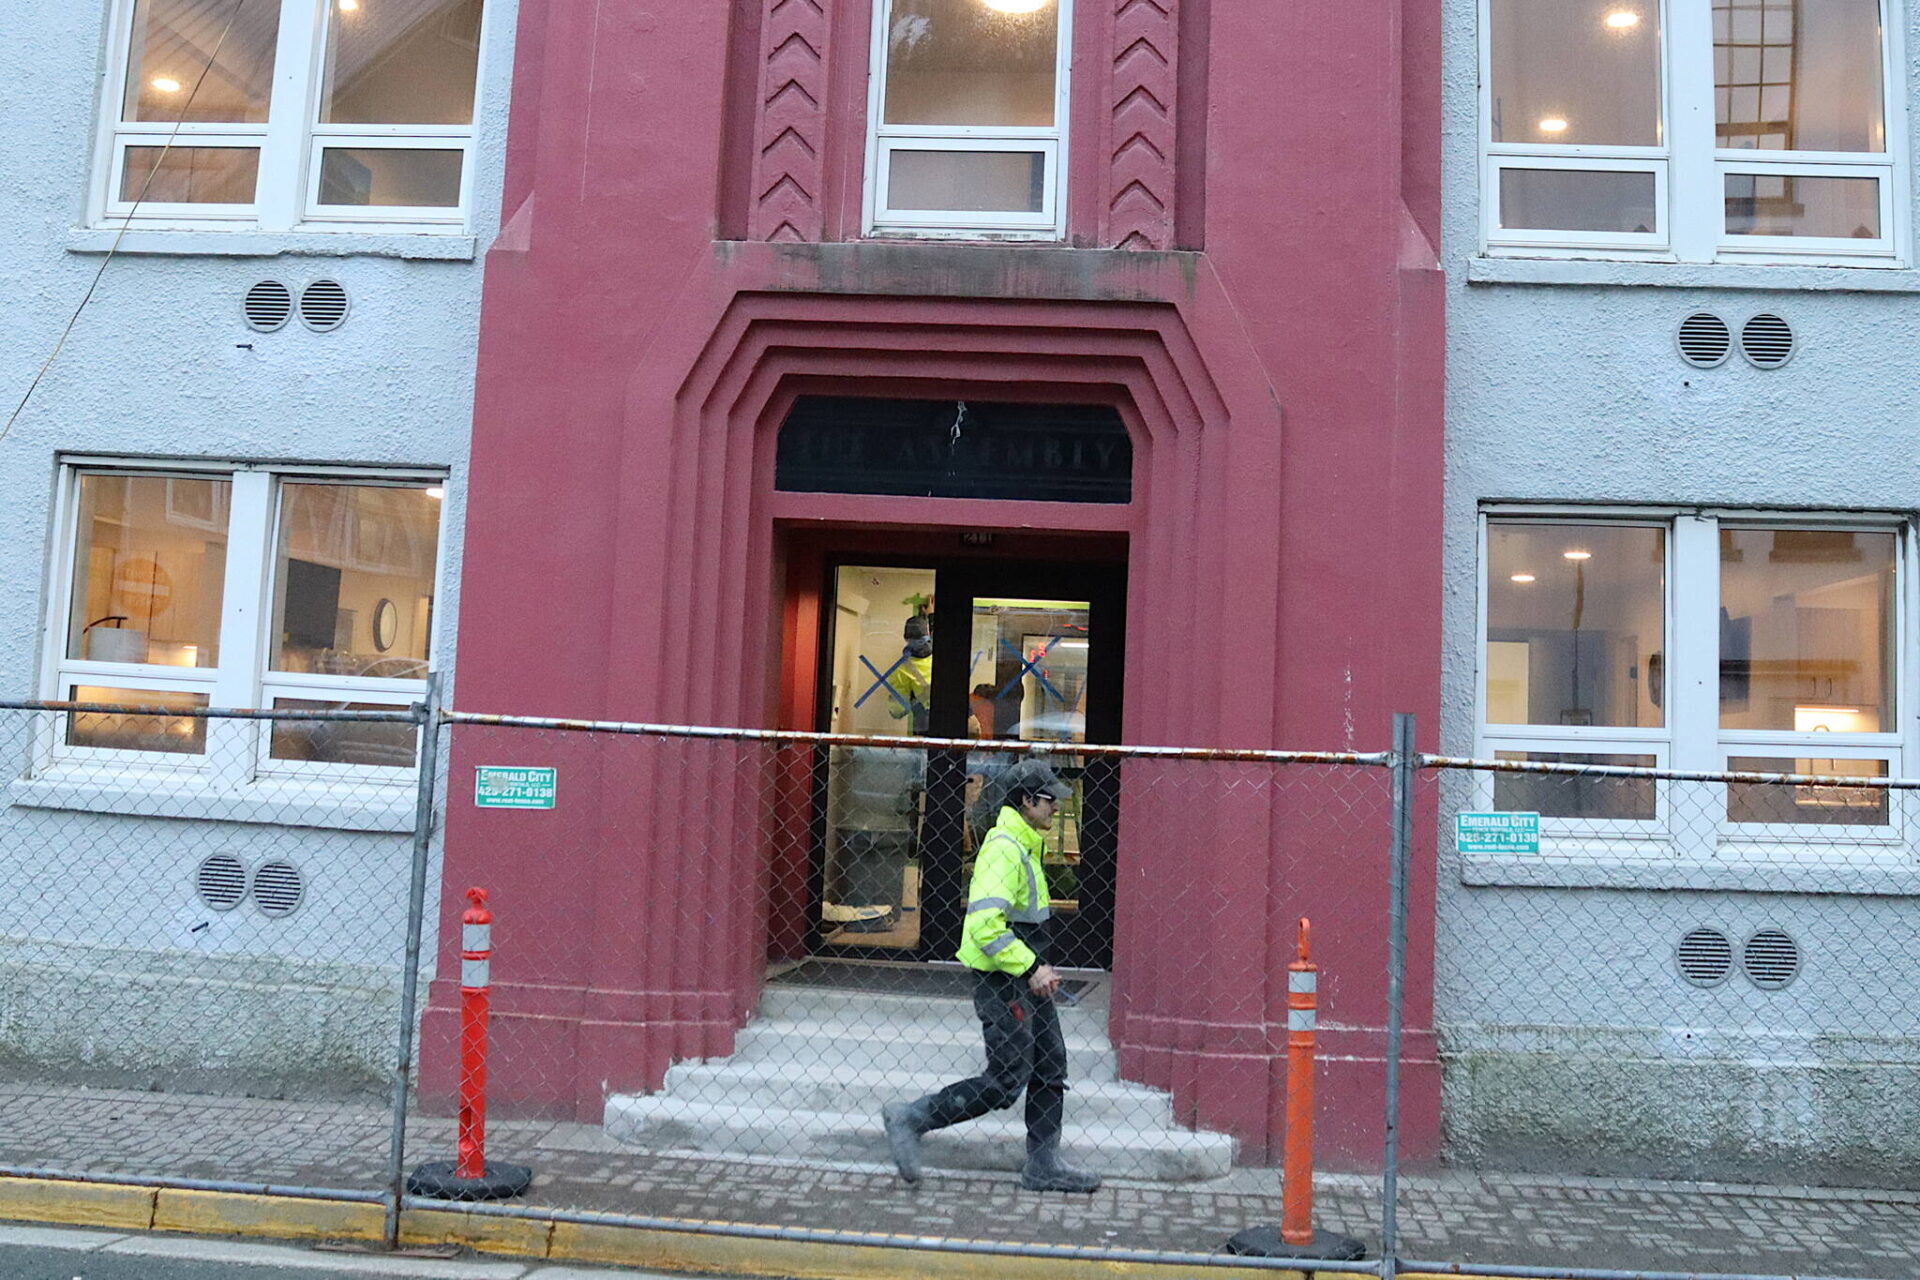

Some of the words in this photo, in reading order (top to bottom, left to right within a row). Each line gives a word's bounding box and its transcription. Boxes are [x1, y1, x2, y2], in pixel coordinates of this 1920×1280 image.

[480, 769, 527, 782] EMERALD
[527, 770, 552, 783] CITY
[1460, 815, 1510, 827] EMERALD
[1510, 815, 1536, 827] CITY
